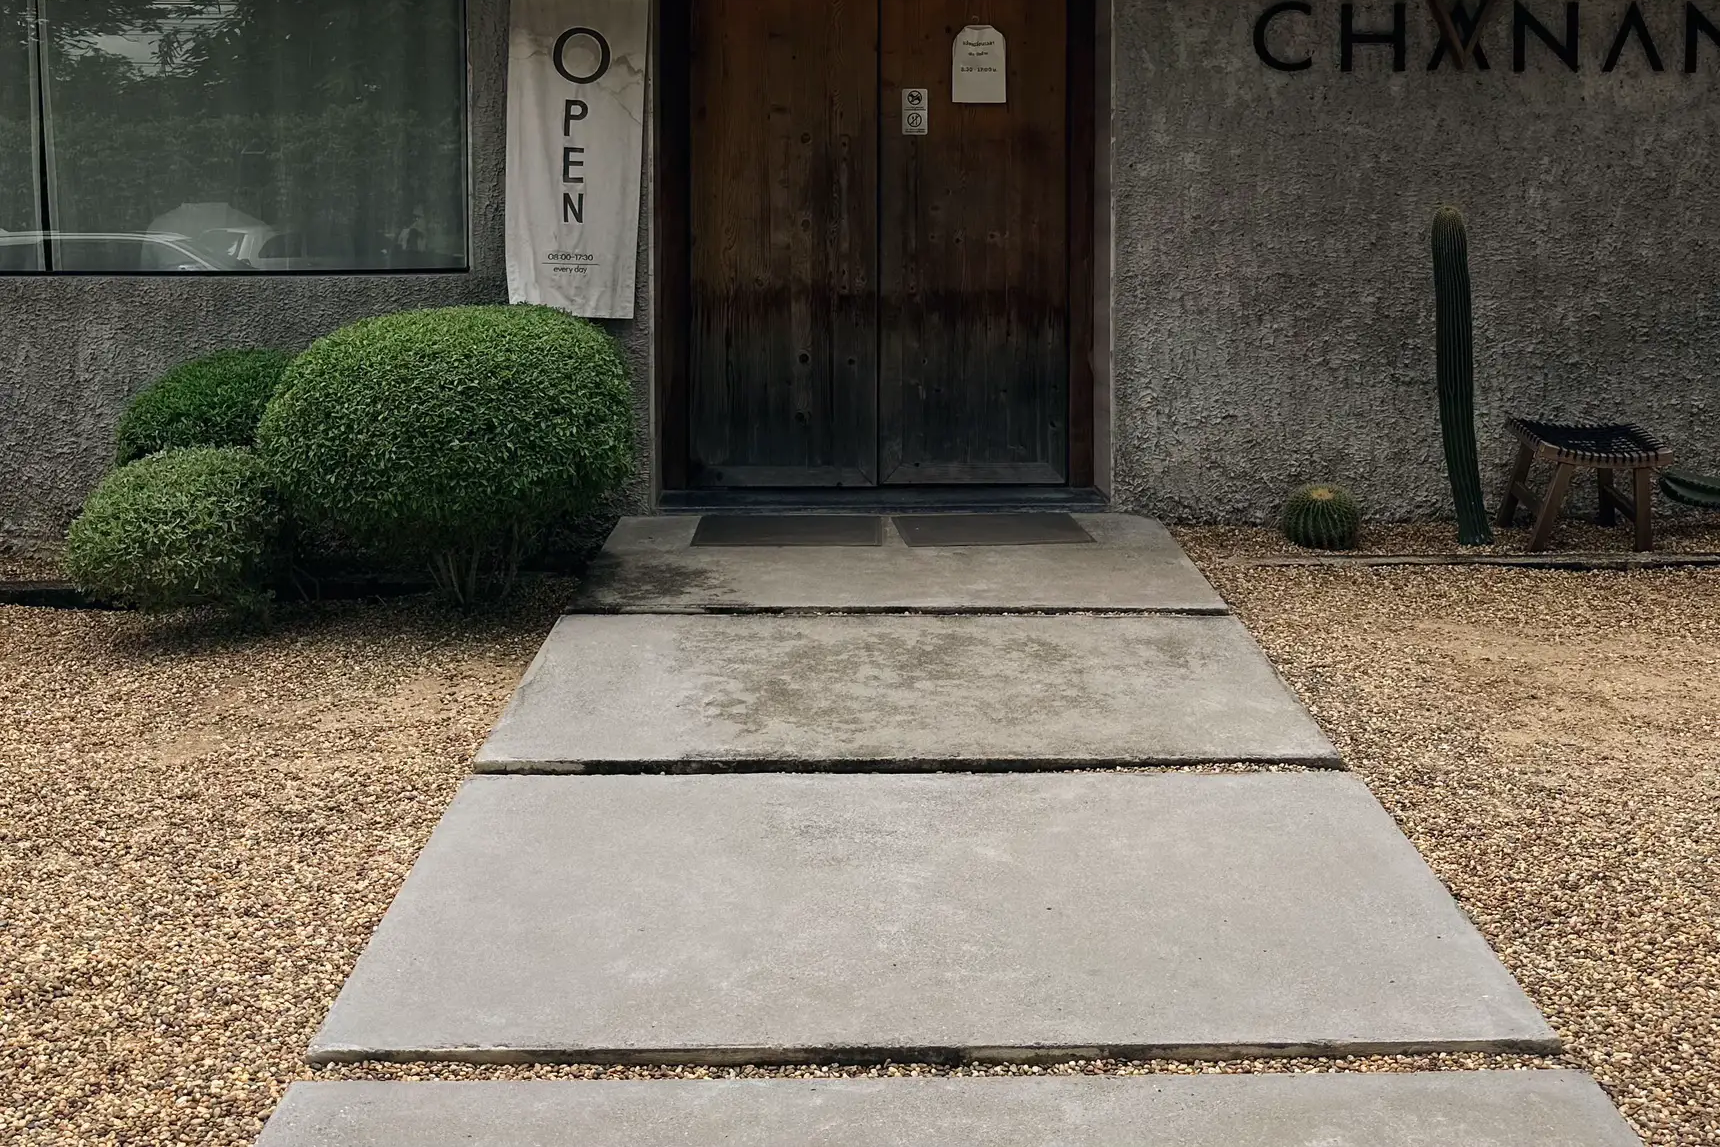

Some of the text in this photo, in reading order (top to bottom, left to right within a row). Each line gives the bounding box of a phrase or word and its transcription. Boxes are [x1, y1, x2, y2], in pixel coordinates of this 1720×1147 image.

[552, 27, 612, 224] OPEN
[553, 265, 587, 274] every day
